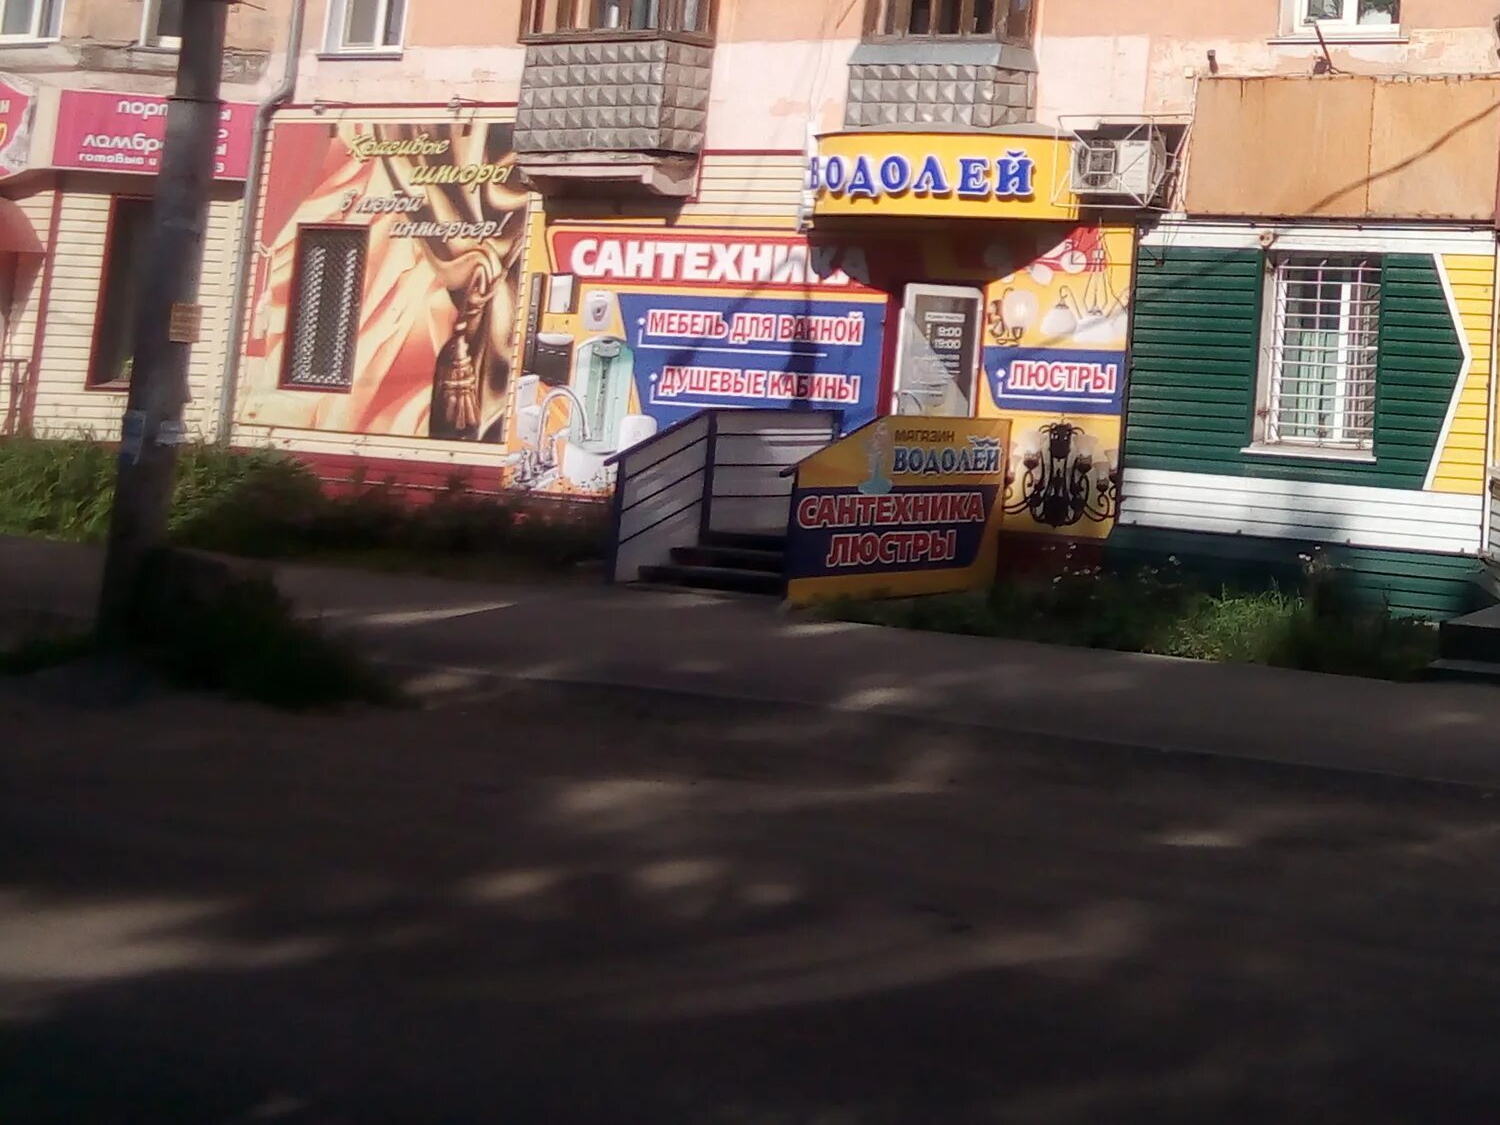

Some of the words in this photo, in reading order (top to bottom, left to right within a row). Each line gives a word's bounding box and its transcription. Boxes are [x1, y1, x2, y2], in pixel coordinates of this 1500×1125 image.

[346, 132, 450, 165] Красивые
[408, 161, 515, 194] шторы
[388, 211, 514, 244] интерьер!
[570, 238, 870, 285] САНТЕХНИКА
[647, 309, 729, 337] МЕБЕЛЬ
[728, 313, 777, 345] ДЛЯ
[777, 312, 865, 345] ВАННОЙ
[660, 365, 768, 398] ДУШЕВЫЕ
[768, 373, 861, 404] КАБИНЫ
[1007, 360, 1117, 393] ЛЮСТРЫ
[894, 430, 954, 442] МАГАЗИН
[893, 443, 1000, 475] ВОДОЛЕЙ
[797, 492, 985, 529] САНТЕХНИКА
[826, 529, 957, 567] ЛЮСТРЫ
